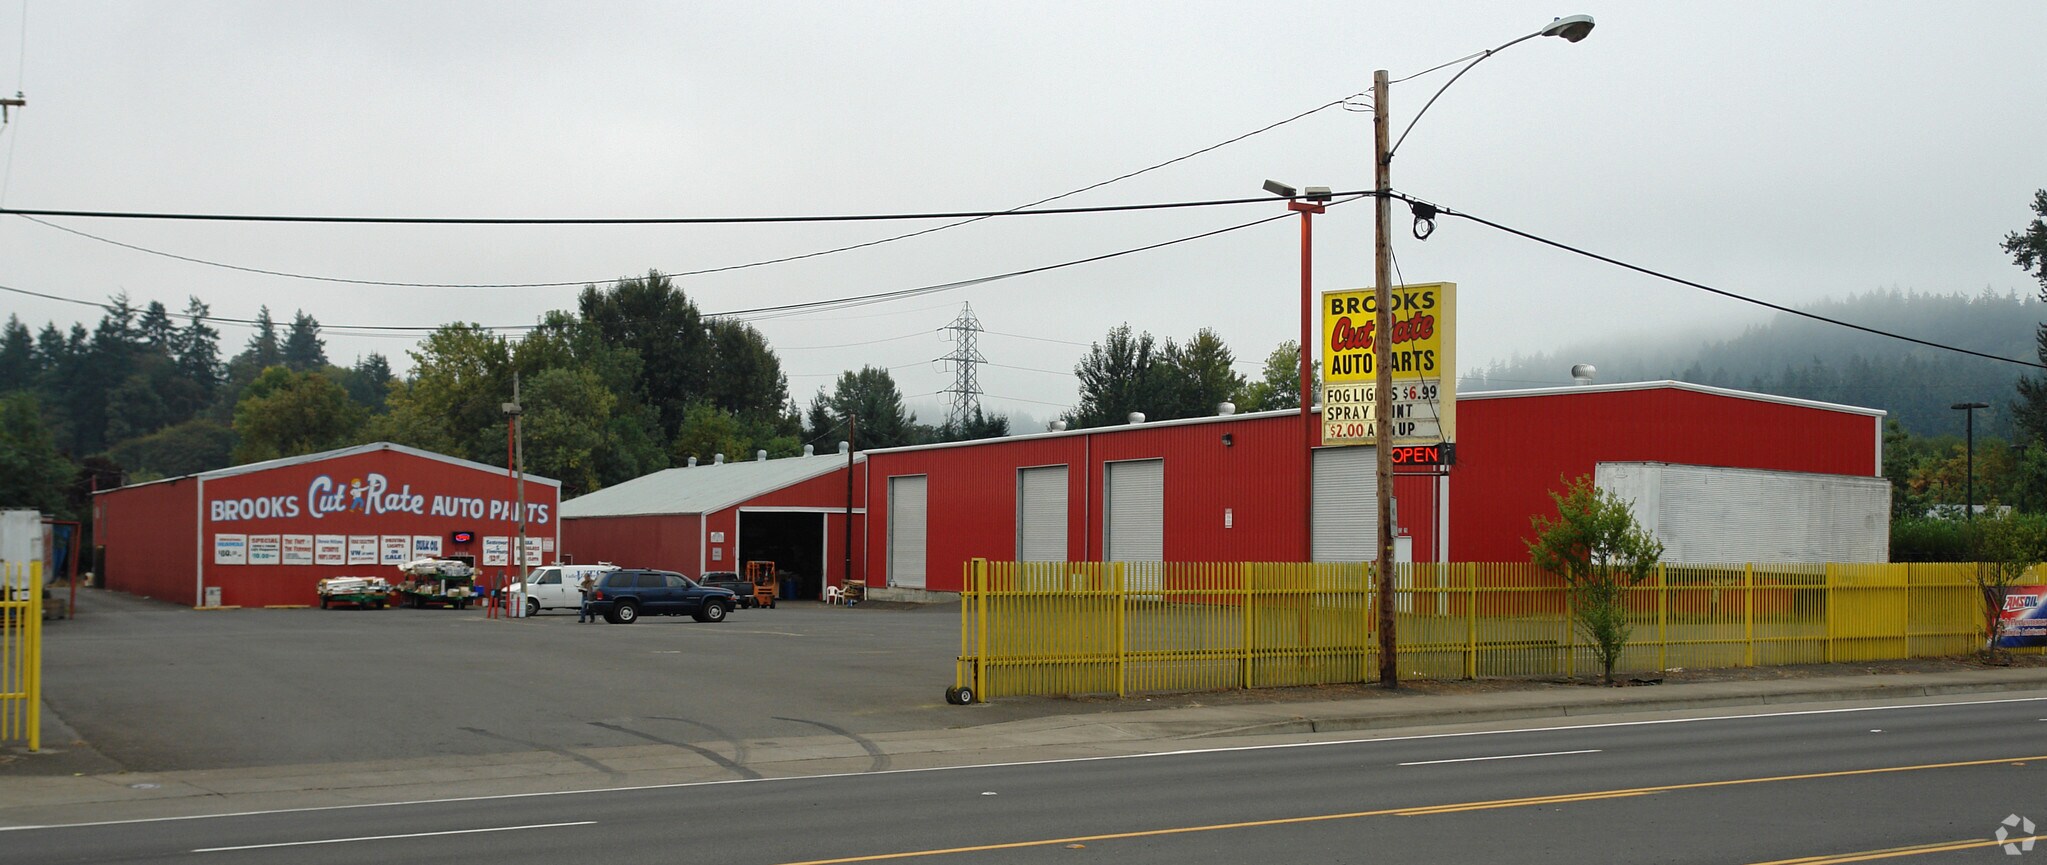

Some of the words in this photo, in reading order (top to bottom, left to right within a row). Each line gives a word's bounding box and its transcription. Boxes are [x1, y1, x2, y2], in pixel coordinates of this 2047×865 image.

[1331, 291, 1435, 315] BROOKS
[1331, 316, 1376, 352] Cut
[1373, 311, 1435, 354] ate
[1331, 353, 1373, 375] AUTO
[1391, 350, 1435, 372] ARTS
[1327, 387, 1351, 403] FOG
[1353, 387, 1398, 402] LIGS
[1403, 384, 1437, 400] $6.99
[1327, 406, 1369, 421] SPRAY
[1375, 403, 1413, 418] INT
[1330, 423, 1364, 438] $2.00
[1398, 422, 1415, 436] UP
[1391, 447, 1438, 463] OPEN
[210, 496, 300, 522] BROOKS
[307, 474, 347, 519] Cut
[364, 472, 425, 516] Rate
[430, 495, 485, 520] AUTO
[415, 539, 429, 551] BULK
[430, 539, 439, 552] OIL
[2004, 595, 2039, 611] AMSOIL
